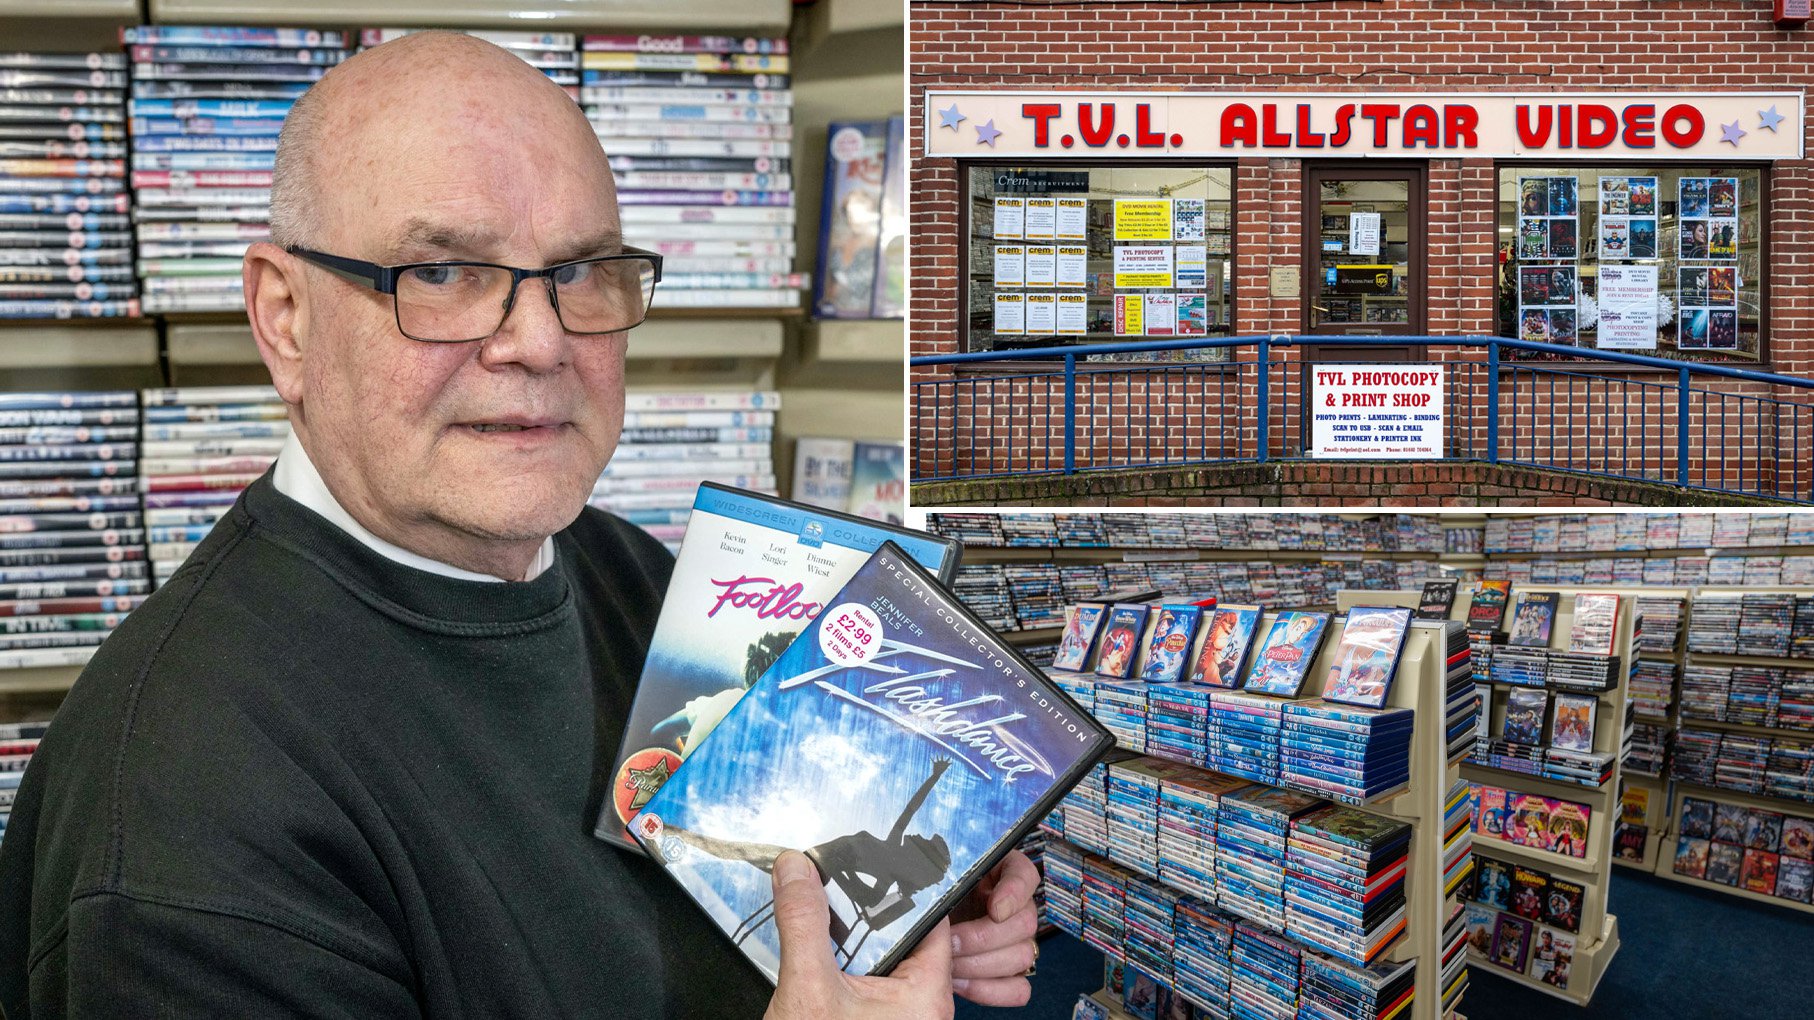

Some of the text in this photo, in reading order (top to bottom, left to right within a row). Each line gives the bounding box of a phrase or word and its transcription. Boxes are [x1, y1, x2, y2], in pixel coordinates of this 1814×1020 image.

[638, 35, 684, 52] Good
[1022, 103, 1705, 148] T.V.L. ALLSTAR VIDEO
[998, 175, 1030, 186] Crem
[1317, 372, 1439, 386] TVL PHOTOCOPY
[1325, 393, 1431, 407] & PRINT SHOP
[714, 499, 797, 526] WIDESCREEN
[720, 531, 747, 556] Kevin Bacon
[762, 543, 788, 568] Lori Singer
[807, 552, 837, 578] Dianne Wiest
[707, 575, 823, 620] Footloo
[853, 609, 874, 629] Rental
[870, 595, 924, 637] JENNIFER BEALS
[1471, 607, 1500, 617] ORCA
[825, 623, 866, 659] 2 films £5
[879, 557, 930, 606] SPECIAL
[936, 608, 1026, 688] COLLECTOR'S
[1030, 691, 1087, 743] EDITION
[832, 644, 847, 660] Days
[778, 638, 1037, 782] Flashdance
[644, 817, 659, 834] 15
[666, 840, 682, 858] 15
[1515, 870, 1547, 887] HOWARD
[1553, 881, 1582, 894] LEGEND
